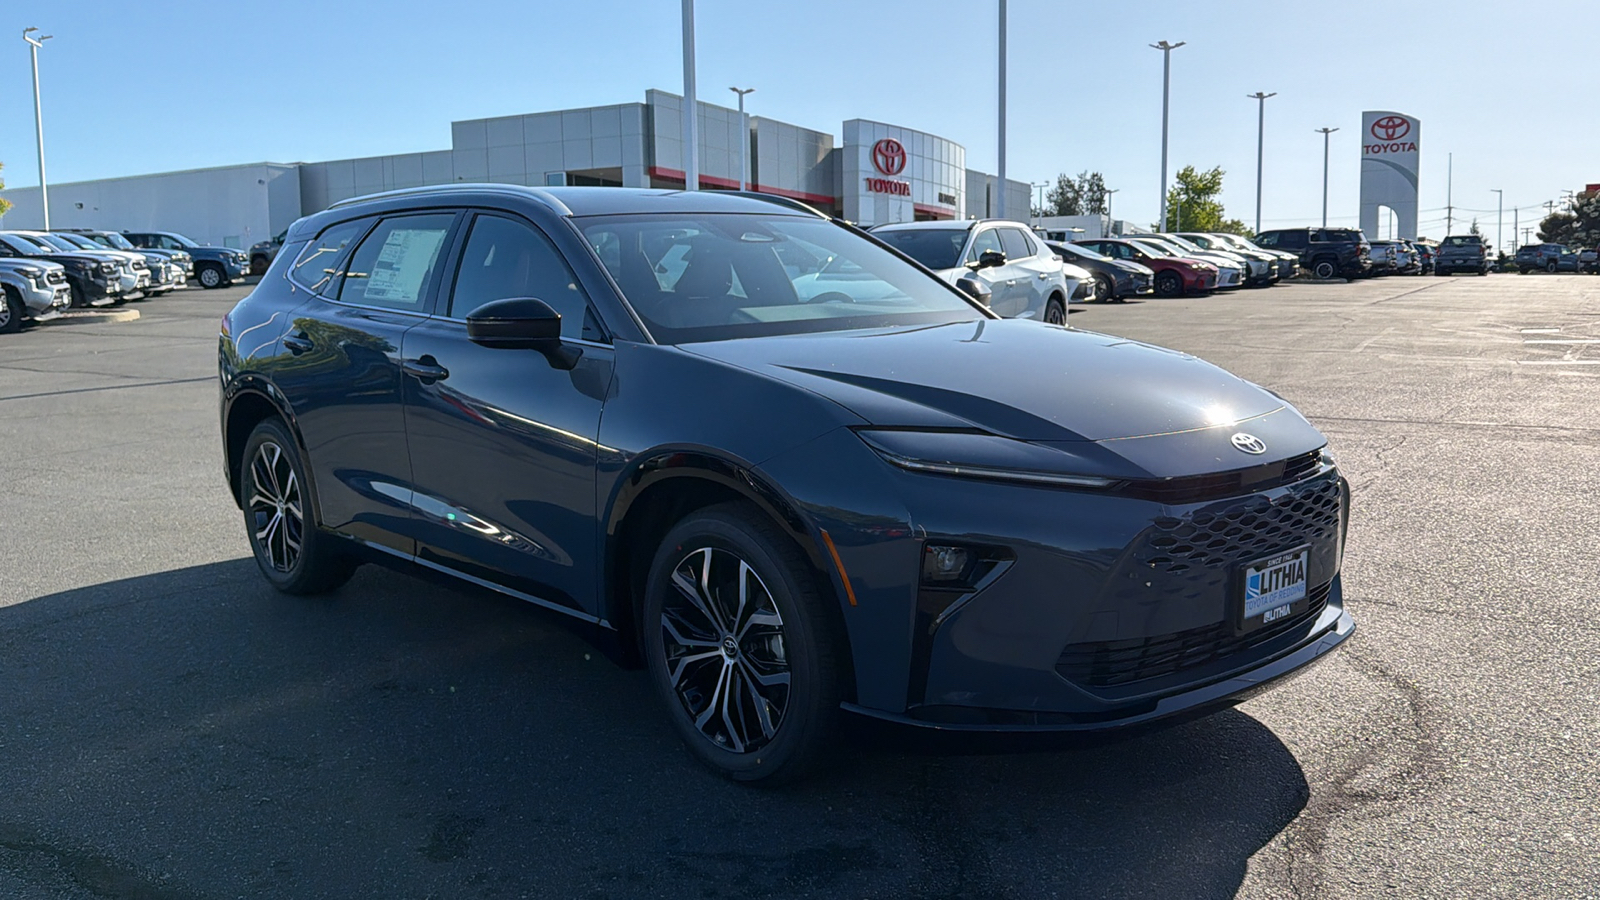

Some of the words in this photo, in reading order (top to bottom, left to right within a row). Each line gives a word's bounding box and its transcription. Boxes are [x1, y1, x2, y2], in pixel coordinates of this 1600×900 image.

[1364, 142, 1417, 154] TOYOTA
[867, 178, 910, 196] TOYOTA
[1267, 557, 1282, 567] SINCE
[1260, 560, 1304, 595] LITHIA
[1246, 597, 1268, 611] TOYOTA
[1269, 593, 1277, 603] OF
[1278, 583, 1305, 599] REDDING
[1270, 604, 1291, 620] LITHIA
